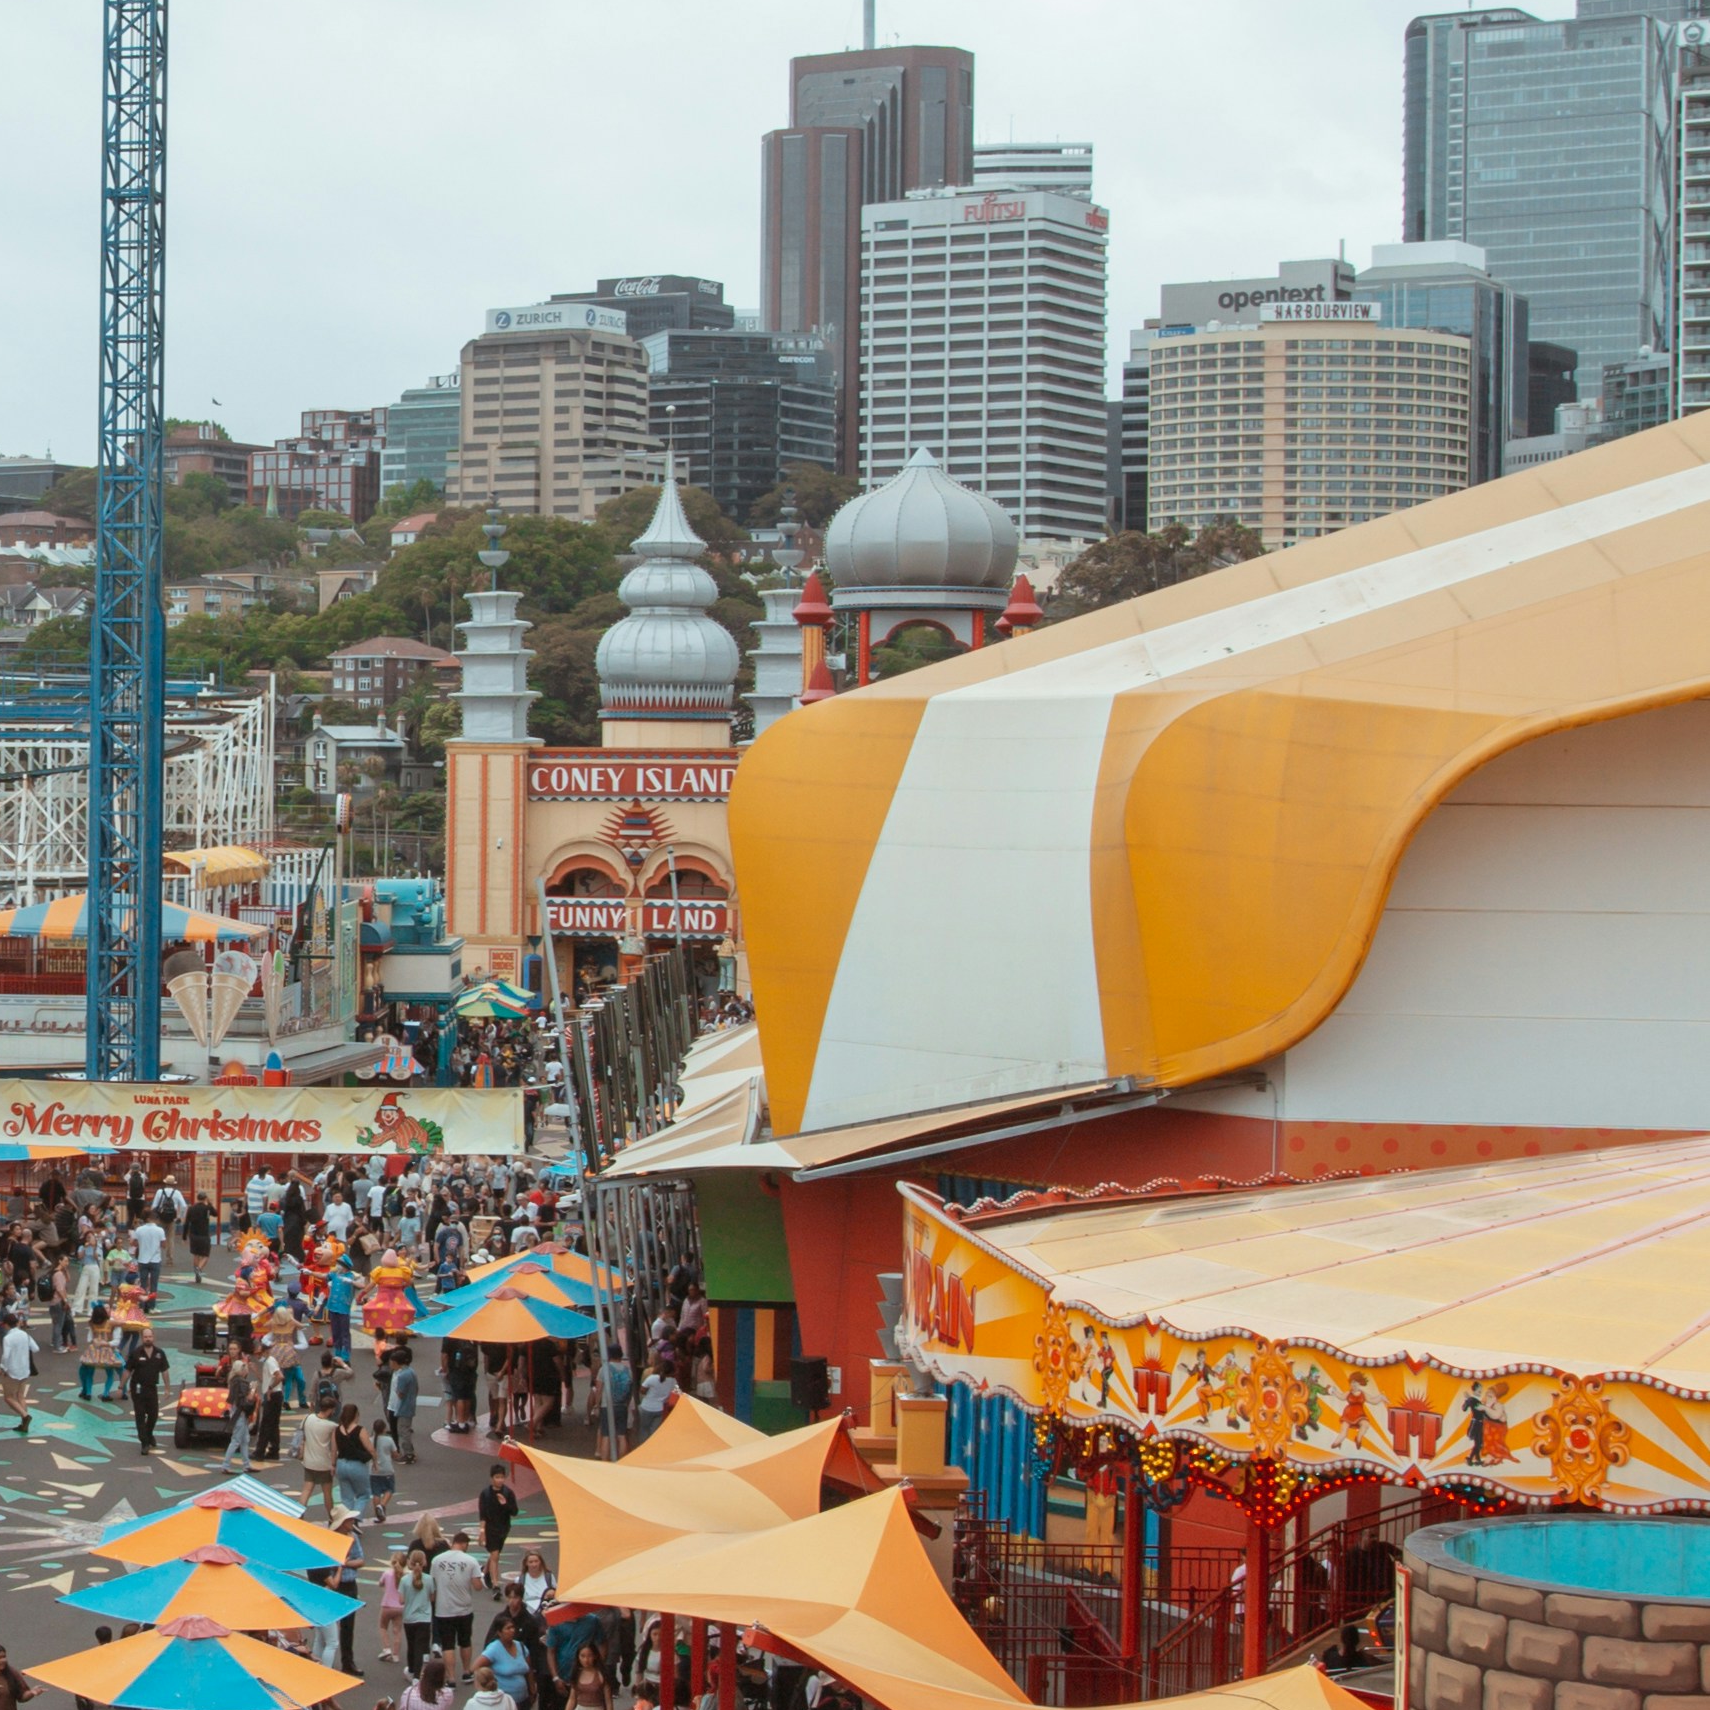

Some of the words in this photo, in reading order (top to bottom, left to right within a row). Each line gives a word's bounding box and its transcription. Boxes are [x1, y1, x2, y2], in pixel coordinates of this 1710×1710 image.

[964, 199, 1026, 225] FUJITSU
[1218, 284, 1326, 313] opentext
[516, 311, 562, 325] ZURICH
[598, 314, 627, 329] ZURICH
[1275, 304, 1372, 320] HARBOURVIEW
[778, 355, 816, 364] aurecon
[531, 766, 626, 793] CONEY
[636, 767, 737, 794] ISLAND
[547, 906, 626, 930] FUNNY
[652, 908, 717, 931] LAND
[133, 1094, 161, 1106] LUNA
[163, 1095, 190, 1106] PARK
[3, 1102, 135, 1147] Merry
[142, 1107, 323, 1144] Christmas
